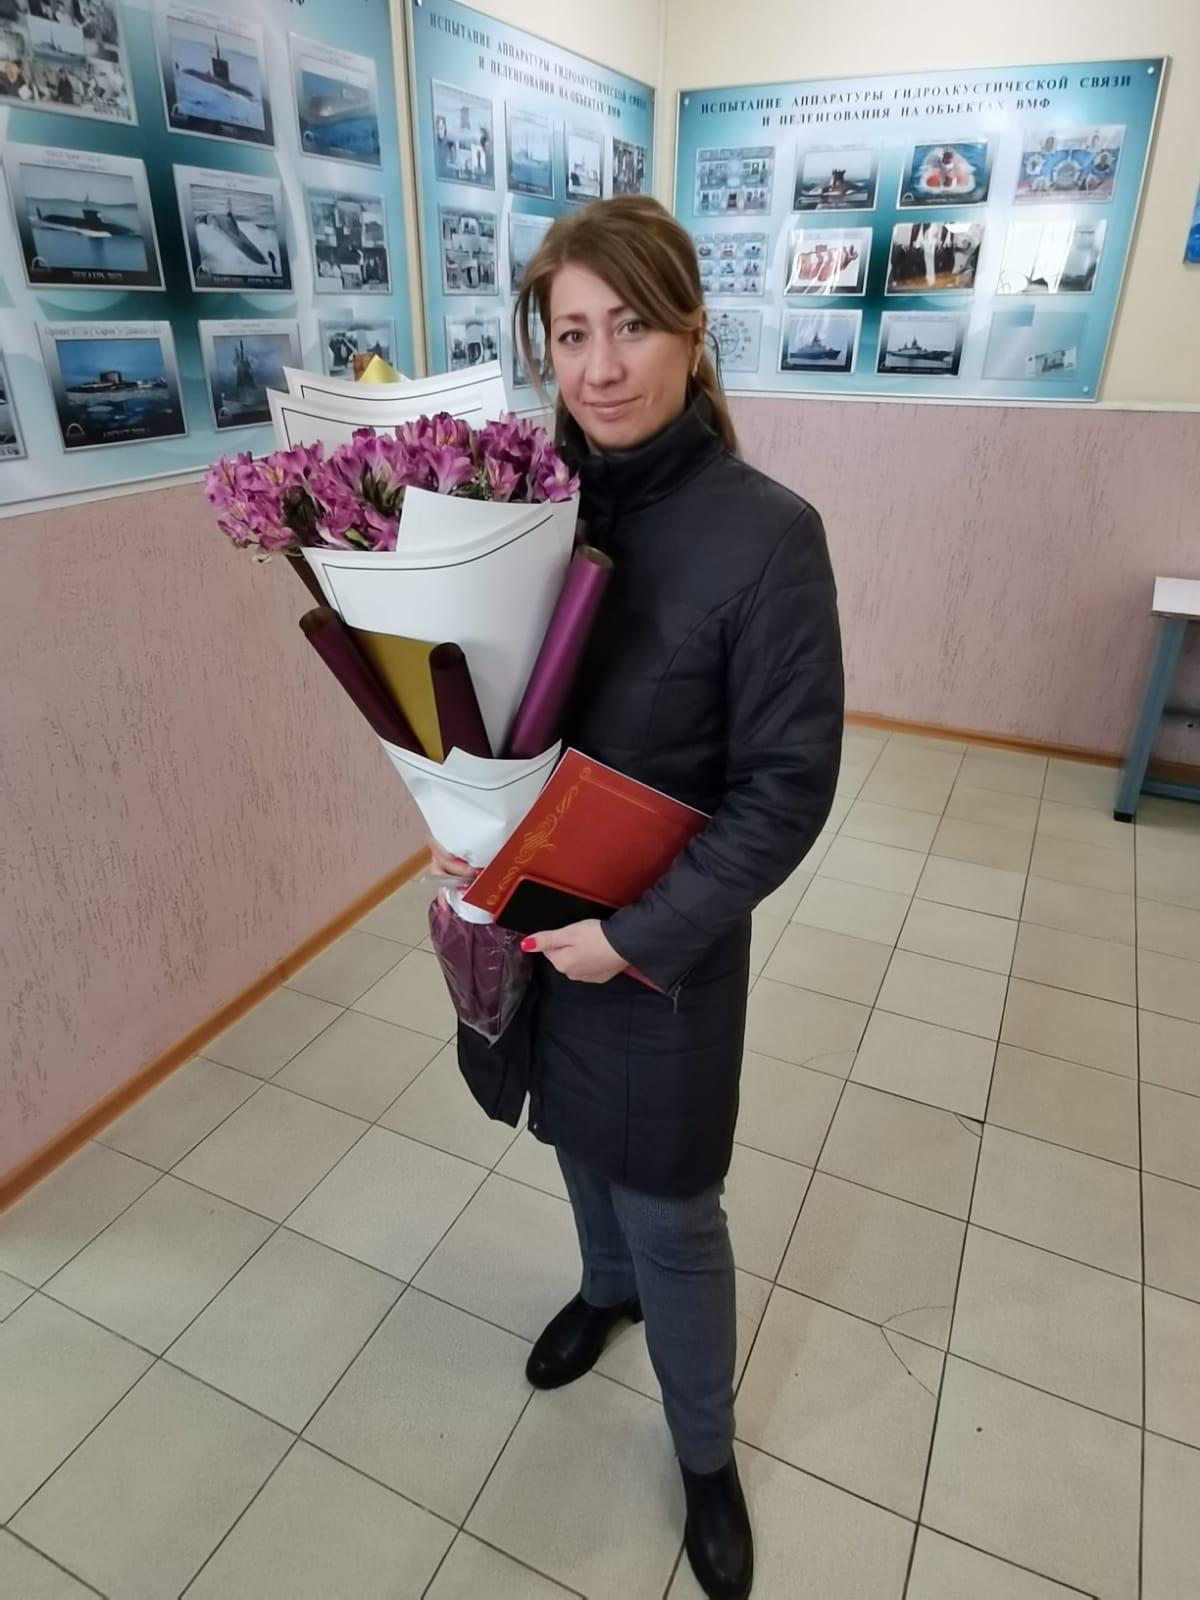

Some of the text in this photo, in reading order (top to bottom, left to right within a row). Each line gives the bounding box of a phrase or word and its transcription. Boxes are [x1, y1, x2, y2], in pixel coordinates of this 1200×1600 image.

[429, 12, 490, 48] ИСПЫТАНИЕ
[497, 41, 551, 72] АППАРАТУРЫ
[478, 55, 485, 70] И
[490, 60, 555, 95] ПЕЛЕНГОВАНИЯ
[559, 83, 569, 99] НА
[569, 90, 604, 112] ОБЪЕКТАХ
[701, 75, 1132, 115] ИСПЫТАНИЕ АППАРАТУРЫ ГИДРОАКУСТИЧЕСКОЙ СВЯЗИ
[762, 97, 1050, 127] И ПЕЛЕНГОВАНИЯ НА ОБЪЕКТАХ ВМФ
